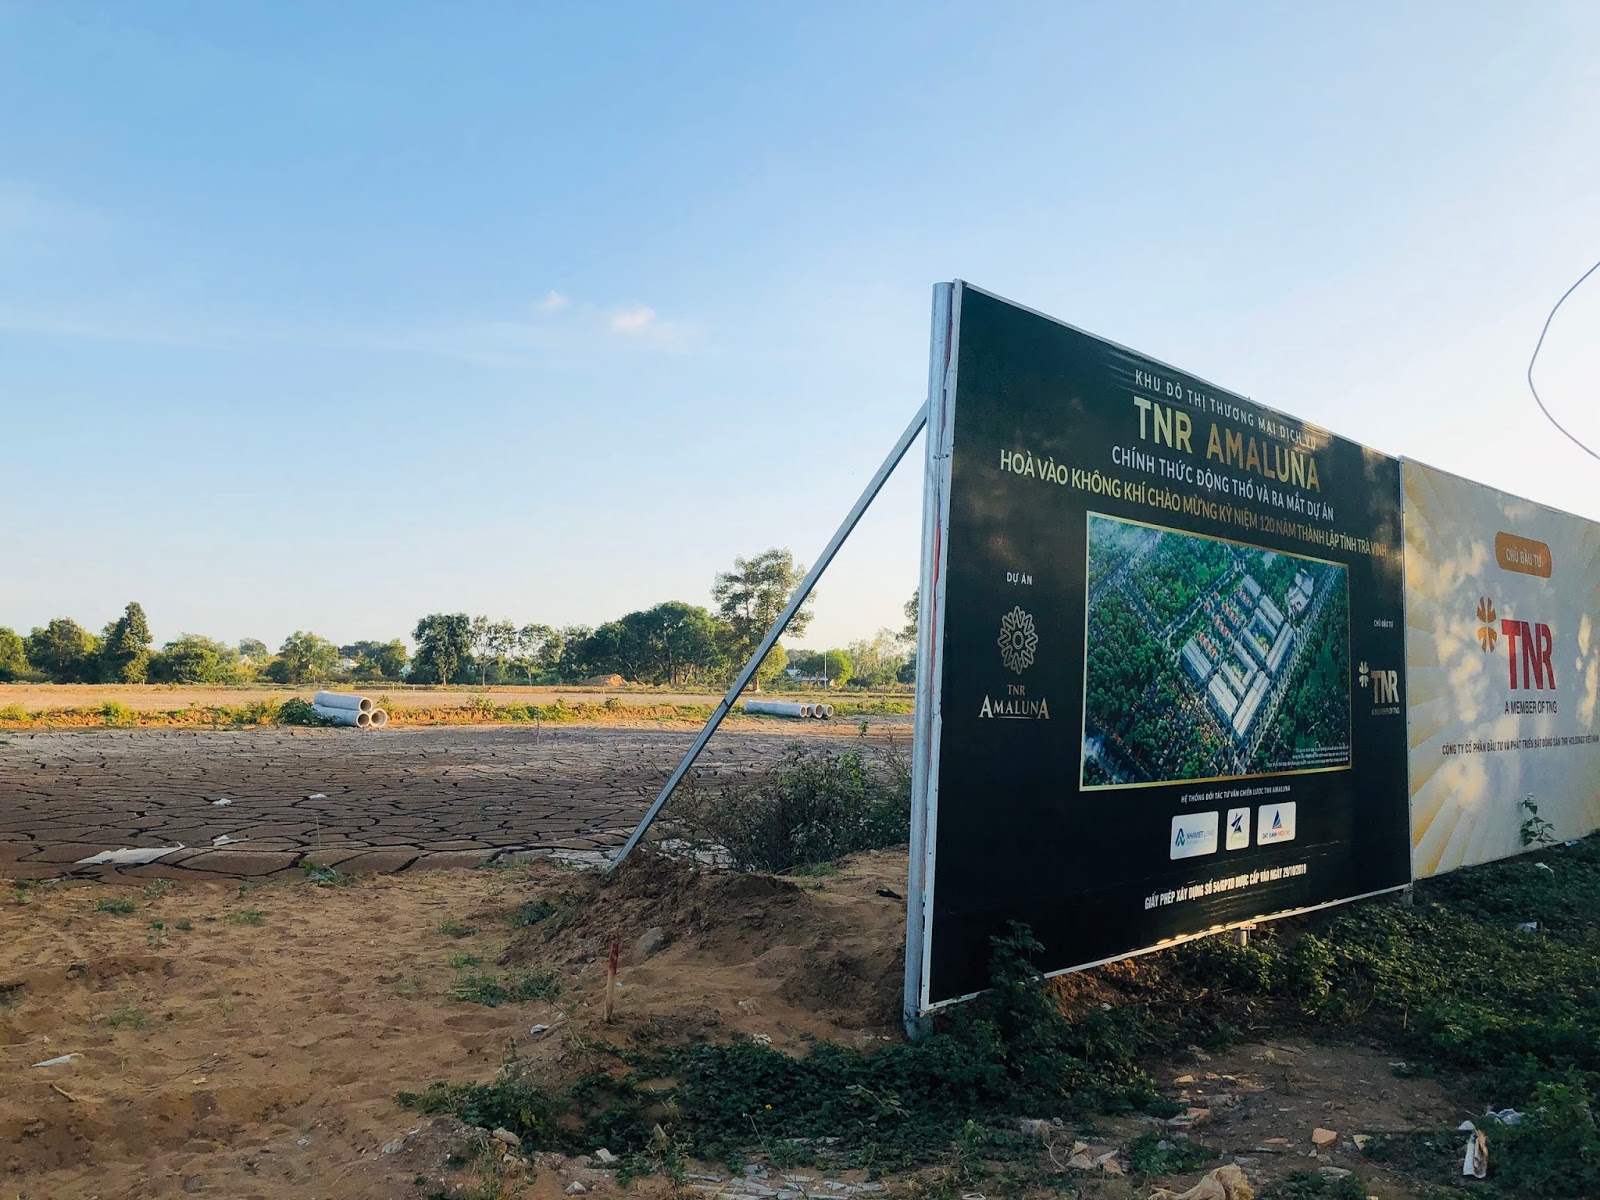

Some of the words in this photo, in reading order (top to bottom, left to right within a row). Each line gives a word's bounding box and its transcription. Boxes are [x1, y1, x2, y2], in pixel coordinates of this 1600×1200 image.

[1135, 369, 1160, 392] KHU
[1166, 382, 1182, 400] ĐÔ
[1187, 389, 1206, 412] THỊ
[1210, 398, 1254, 427] THƯƠNG
[1258, 417, 1276, 436] MẠI
[1280, 425, 1301, 445] DỊCH
[1133, 396, 1193, 454] TNR
[1206, 423, 1320, 493] AMALUNA
[1112, 445, 1155, 474] CHÍNH
[1159, 459, 1193, 484] THỨC
[1196, 468, 1229, 493] ĐỘNG
[1232, 478, 1254, 500] THỔ
[1256, 484, 1270, 505] VÀ
[1272, 490, 1284, 508] RA
[1286, 491, 1305, 514] MẮT
[1307, 501, 1320, 521] DỰ
[1322, 502, 1334, 521] ÁN
[1000, 449, 1035, 478] HOÀ
[1037, 456, 1068, 485] VÀO
[1072, 468, 1121, 498] KHÔNG
[1124, 481, 1146, 504] KHÍ
[1148, 487, 1180, 511] CHÀO
[1183, 494, 1218, 520] MỪNG
[1220, 502, 1232, 523] KỶ
[1234, 507, 1258, 531] NIỆM
[1260, 515, 1274, 533] 120
[1277, 517, 1296, 538] NĂM
[1299, 523, 1325, 544] THÀNH
[1326, 529, 1339, 550] LẬP
[1358, 537, 1371, 554] TRÀ
[1371, 542, 1387, 557] VINH
[1006, 572, 1019, 585] DỰ
[1021, 572, 1033, 585] ÁN
[1501, 618, 1556, 690] TNR
[1007, 684, 1025, 696] TNR
[1371, 670, 1399, 703] TNR
[978, 695, 1050, 720] AMALUNA
[1505, 701, 1510, 714] A
[1510, 701, 1537, 714] MEMBER
[1537, 701, 1545, 713] OF
[1545, 701, 1557, 714] TNG
[1442, 742, 1457, 755] CÔNG
[1457, 743, 1465, 754] TY
[1145, 891, 1159, 910] GIẤY
[1160, 889, 1175, 906] PHÉP
[1204, 878, 1212, 895] SỐ
